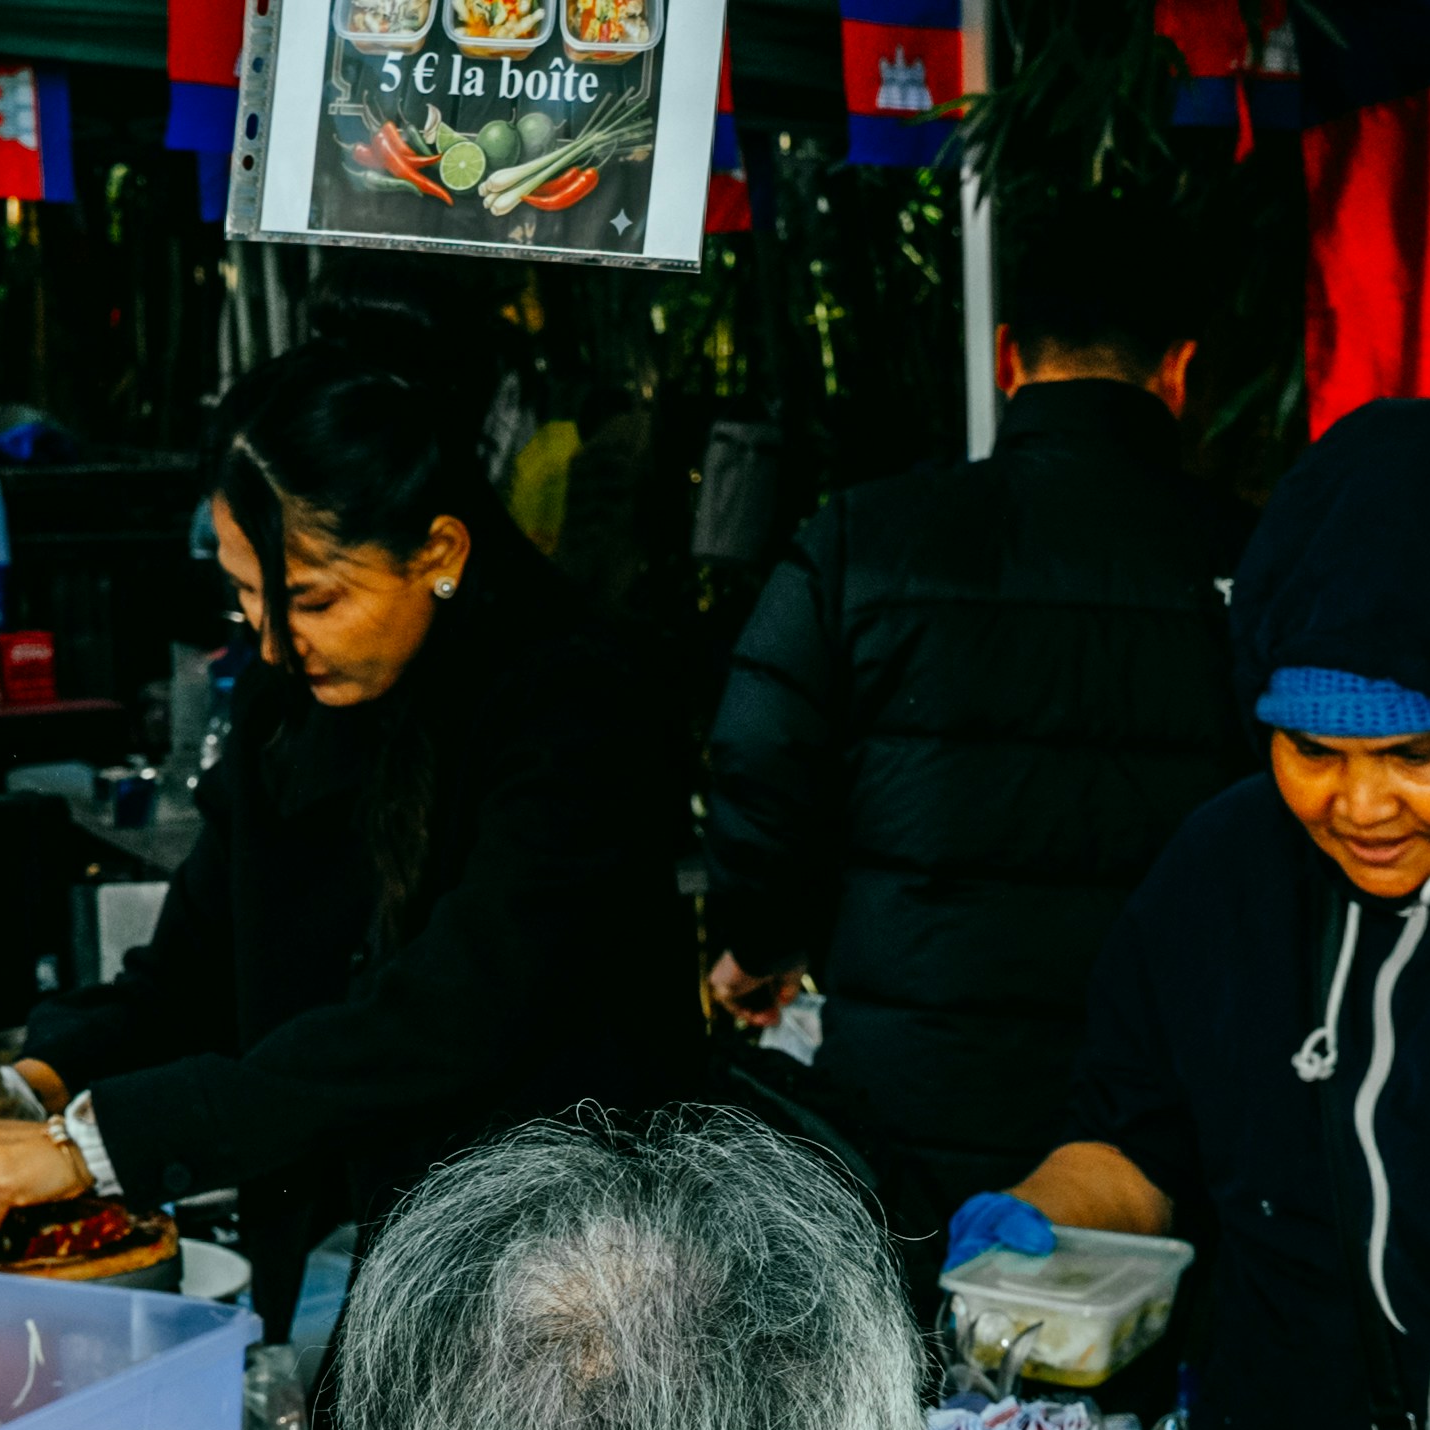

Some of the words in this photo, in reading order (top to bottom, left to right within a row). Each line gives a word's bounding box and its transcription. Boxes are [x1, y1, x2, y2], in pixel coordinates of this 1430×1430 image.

[380, 52, 404, 92] 5
[413, 52, 439, 94] €
[448, 54, 485, 97] la
[499, 57, 599, 103] boîte
